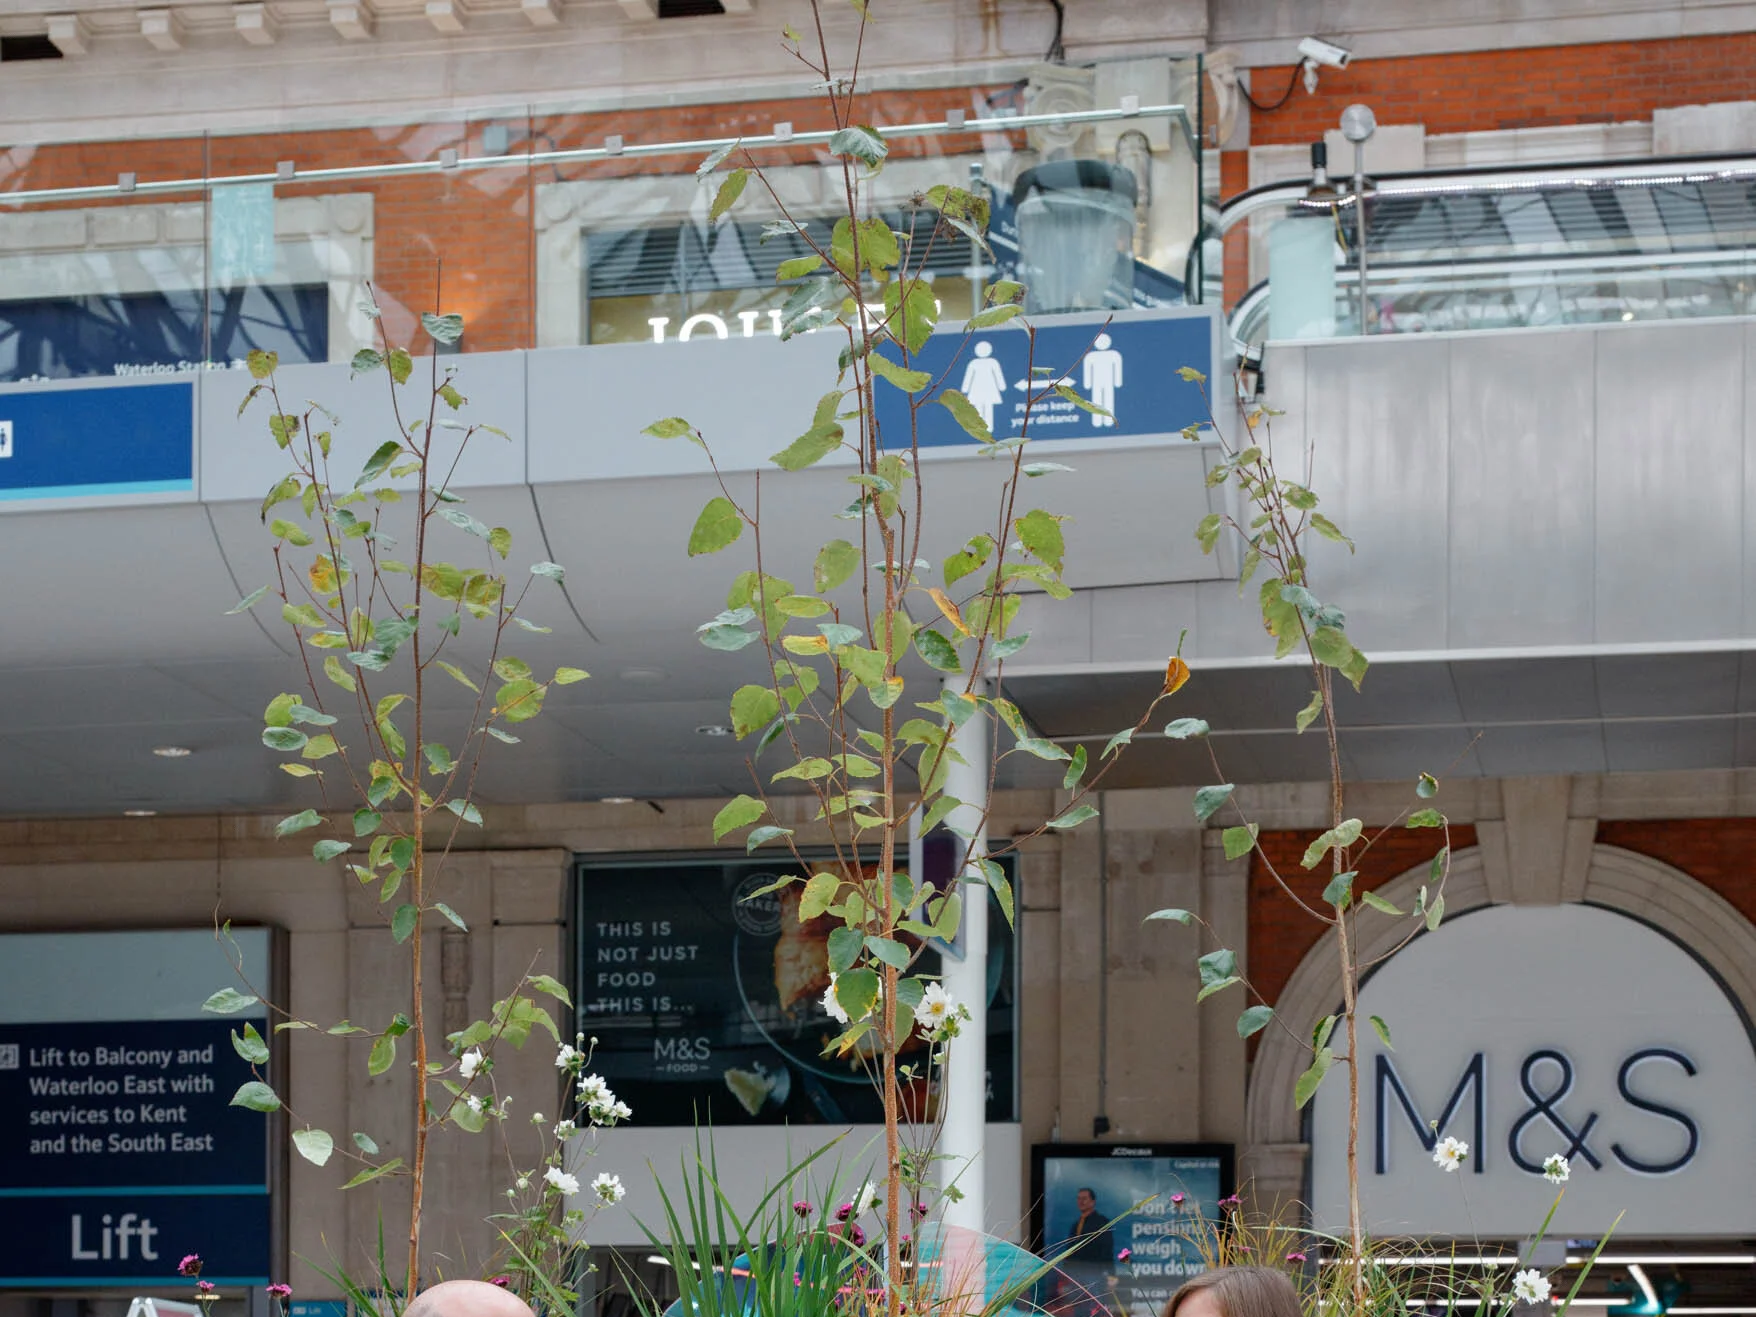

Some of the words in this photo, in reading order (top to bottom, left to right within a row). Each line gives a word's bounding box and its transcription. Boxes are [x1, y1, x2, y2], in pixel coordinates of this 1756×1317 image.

[114, 362, 175, 376] Waterloo
[1036, 414, 1080, 424] distance
[597, 922, 643, 937] THIS
[652, 921, 671, 936] IS
[597, 947, 639, 962] NOT
[647, 945, 699, 961] JUST
[597, 972, 656, 987] FOOD
[597, 997, 644, 1012] THIS
[29, 1047, 64, 1067] Lift
[69, 1049, 90, 1066] to
[95, 1046, 173, 1069] Balcony
[177, 1044, 214, 1064] and
[653, 1036, 711, 1061] M&S
[666, 1063, 698, 1073] FOOD
[29, 1076, 119, 1096] Waterloo
[124, 1075, 166, 1093] East
[171, 1073, 214, 1092] with
[29, 1105, 109, 1125] services
[114, 1106, 135, 1123] to
[140, 1104, 187, 1123] Kent
[1375, 1049, 1699, 1175] M&S
[29, 1135, 65, 1154] and
[70, 1134, 103, 1153] the
[108, 1133, 166, 1152] South
[171, 1132, 214, 1151] East
[71, 1213, 158, 1260] Lift
[1131, 1239, 1181, 1259] weigh
[1132, 1263, 1162, 1278] you
